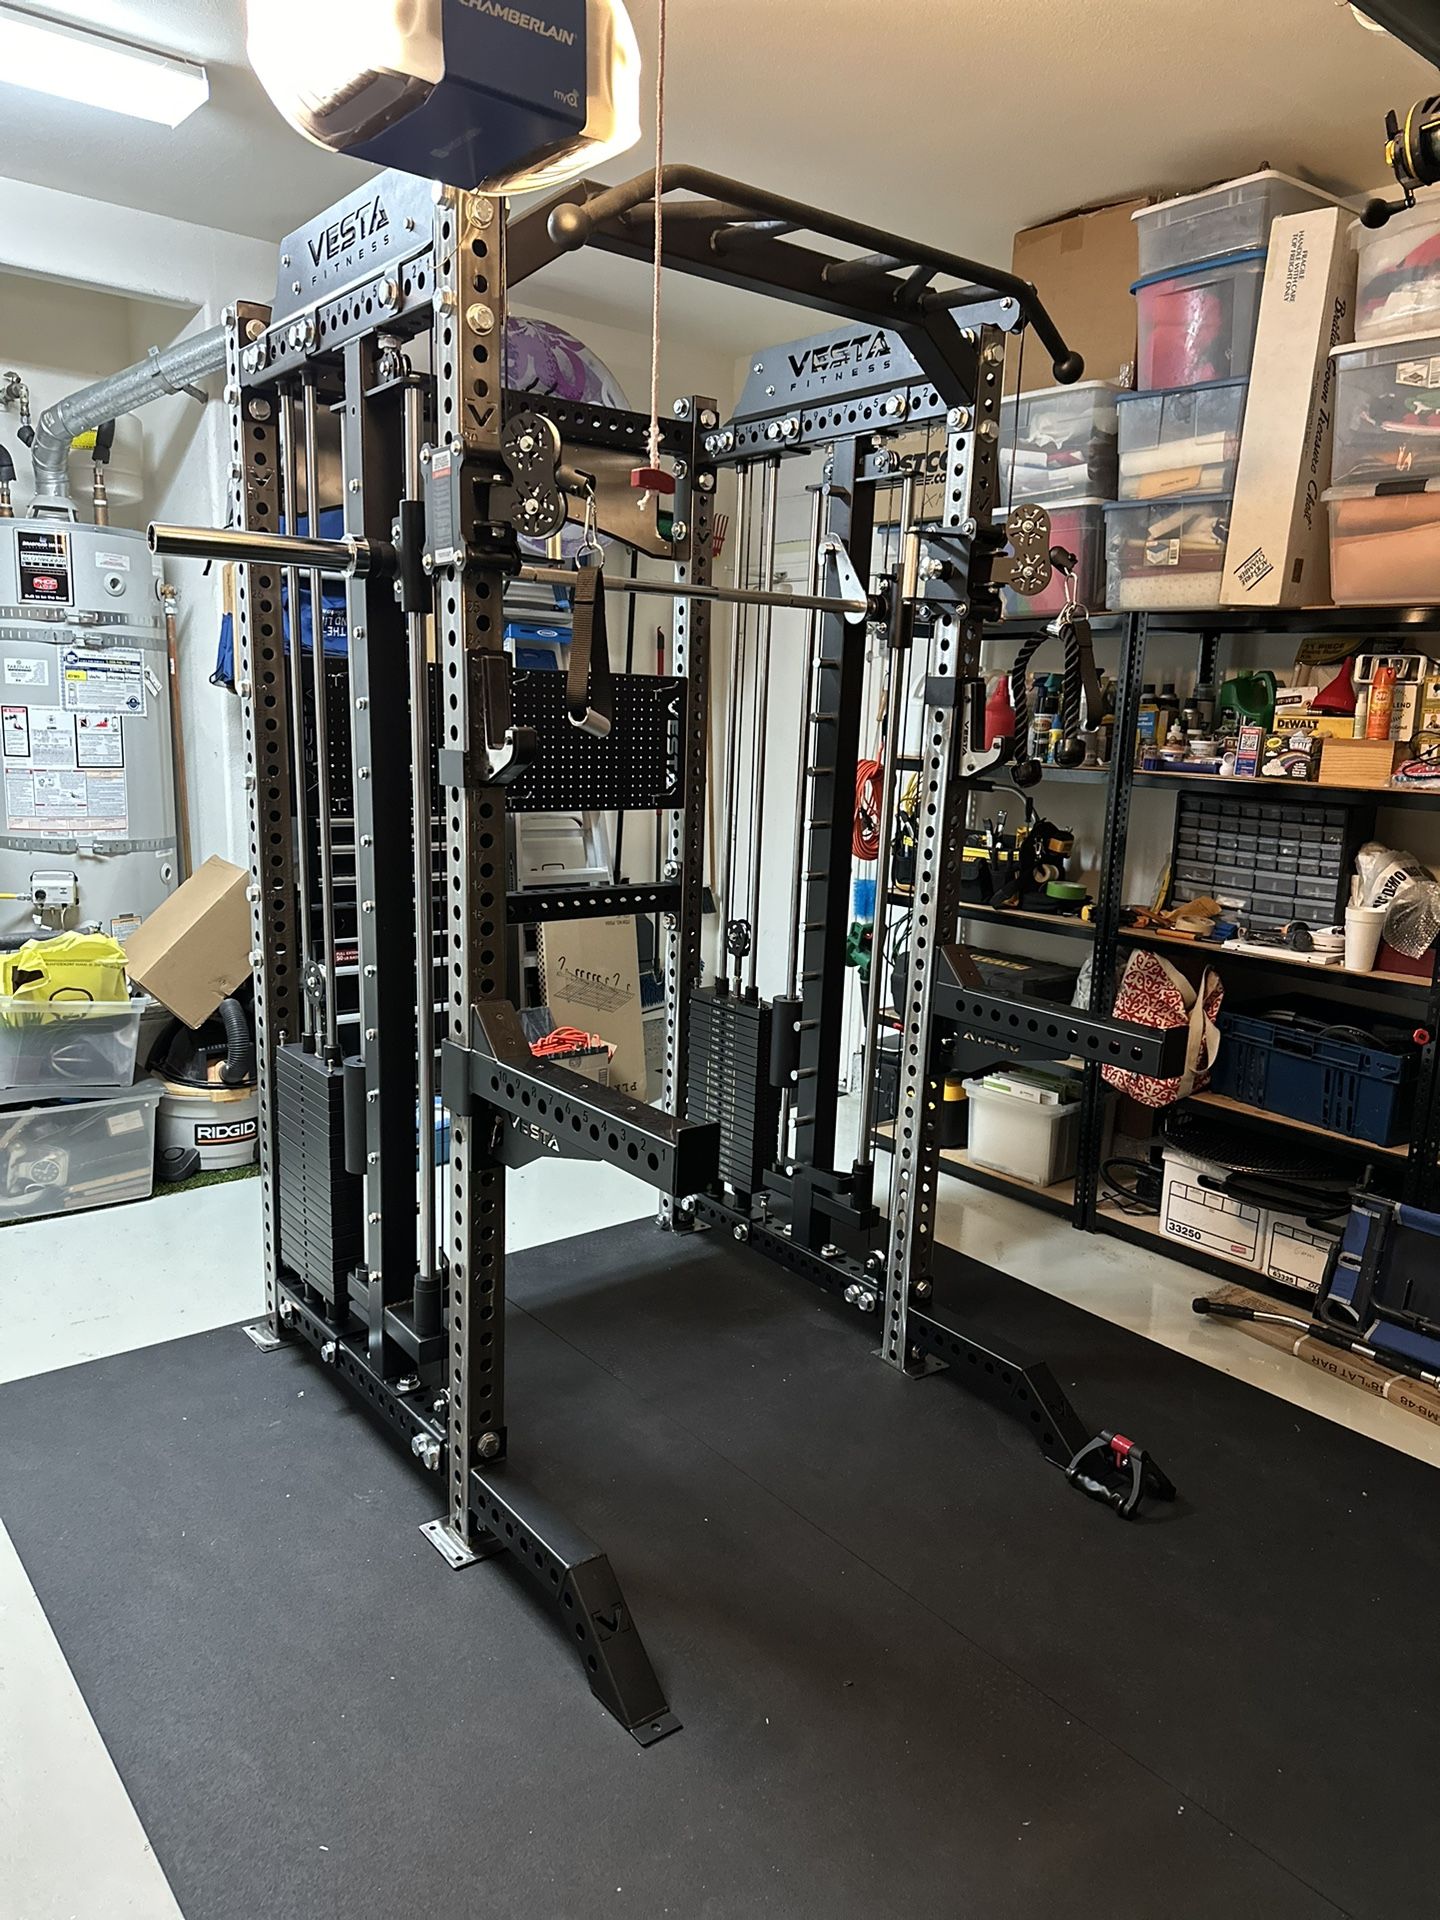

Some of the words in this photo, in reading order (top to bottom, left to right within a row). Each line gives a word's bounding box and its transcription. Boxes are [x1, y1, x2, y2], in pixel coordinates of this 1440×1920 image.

[307, 195, 390, 268] VESTA
[311, 235, 390, 286] FITNESS
[787, 329, 891, 378] VESTA
[790, 360, 891, 392] FITNESS
[923, 387, 929, 398] 2
[962, 720, 970, 757] VESTA
[1277, 719, 1319, 729] DEWALT
[665, 697, 680, 789] VESTA
[499, 1070, 507, 1083] 10
[516, 1079, 521, 1090] 9
[531, 1086, 537, 1098] 8
[548, 1095, 553, 1105] 7
[565, 1103, 570, 1114] 6
[583, 1111, 588, 1123] 5
[601, 1121, 607, 1132] 4
[620, 1129, 626, 1141] 3
[641, 1138, 646, 1150] 2
[197, 1121, 256, 1139] RIDGID
[509, 1113, 561, 1153] VESTA
[1168, 1221, 1202, 1241] 33250
[1311, 1354, 1338, 1374] BAR
